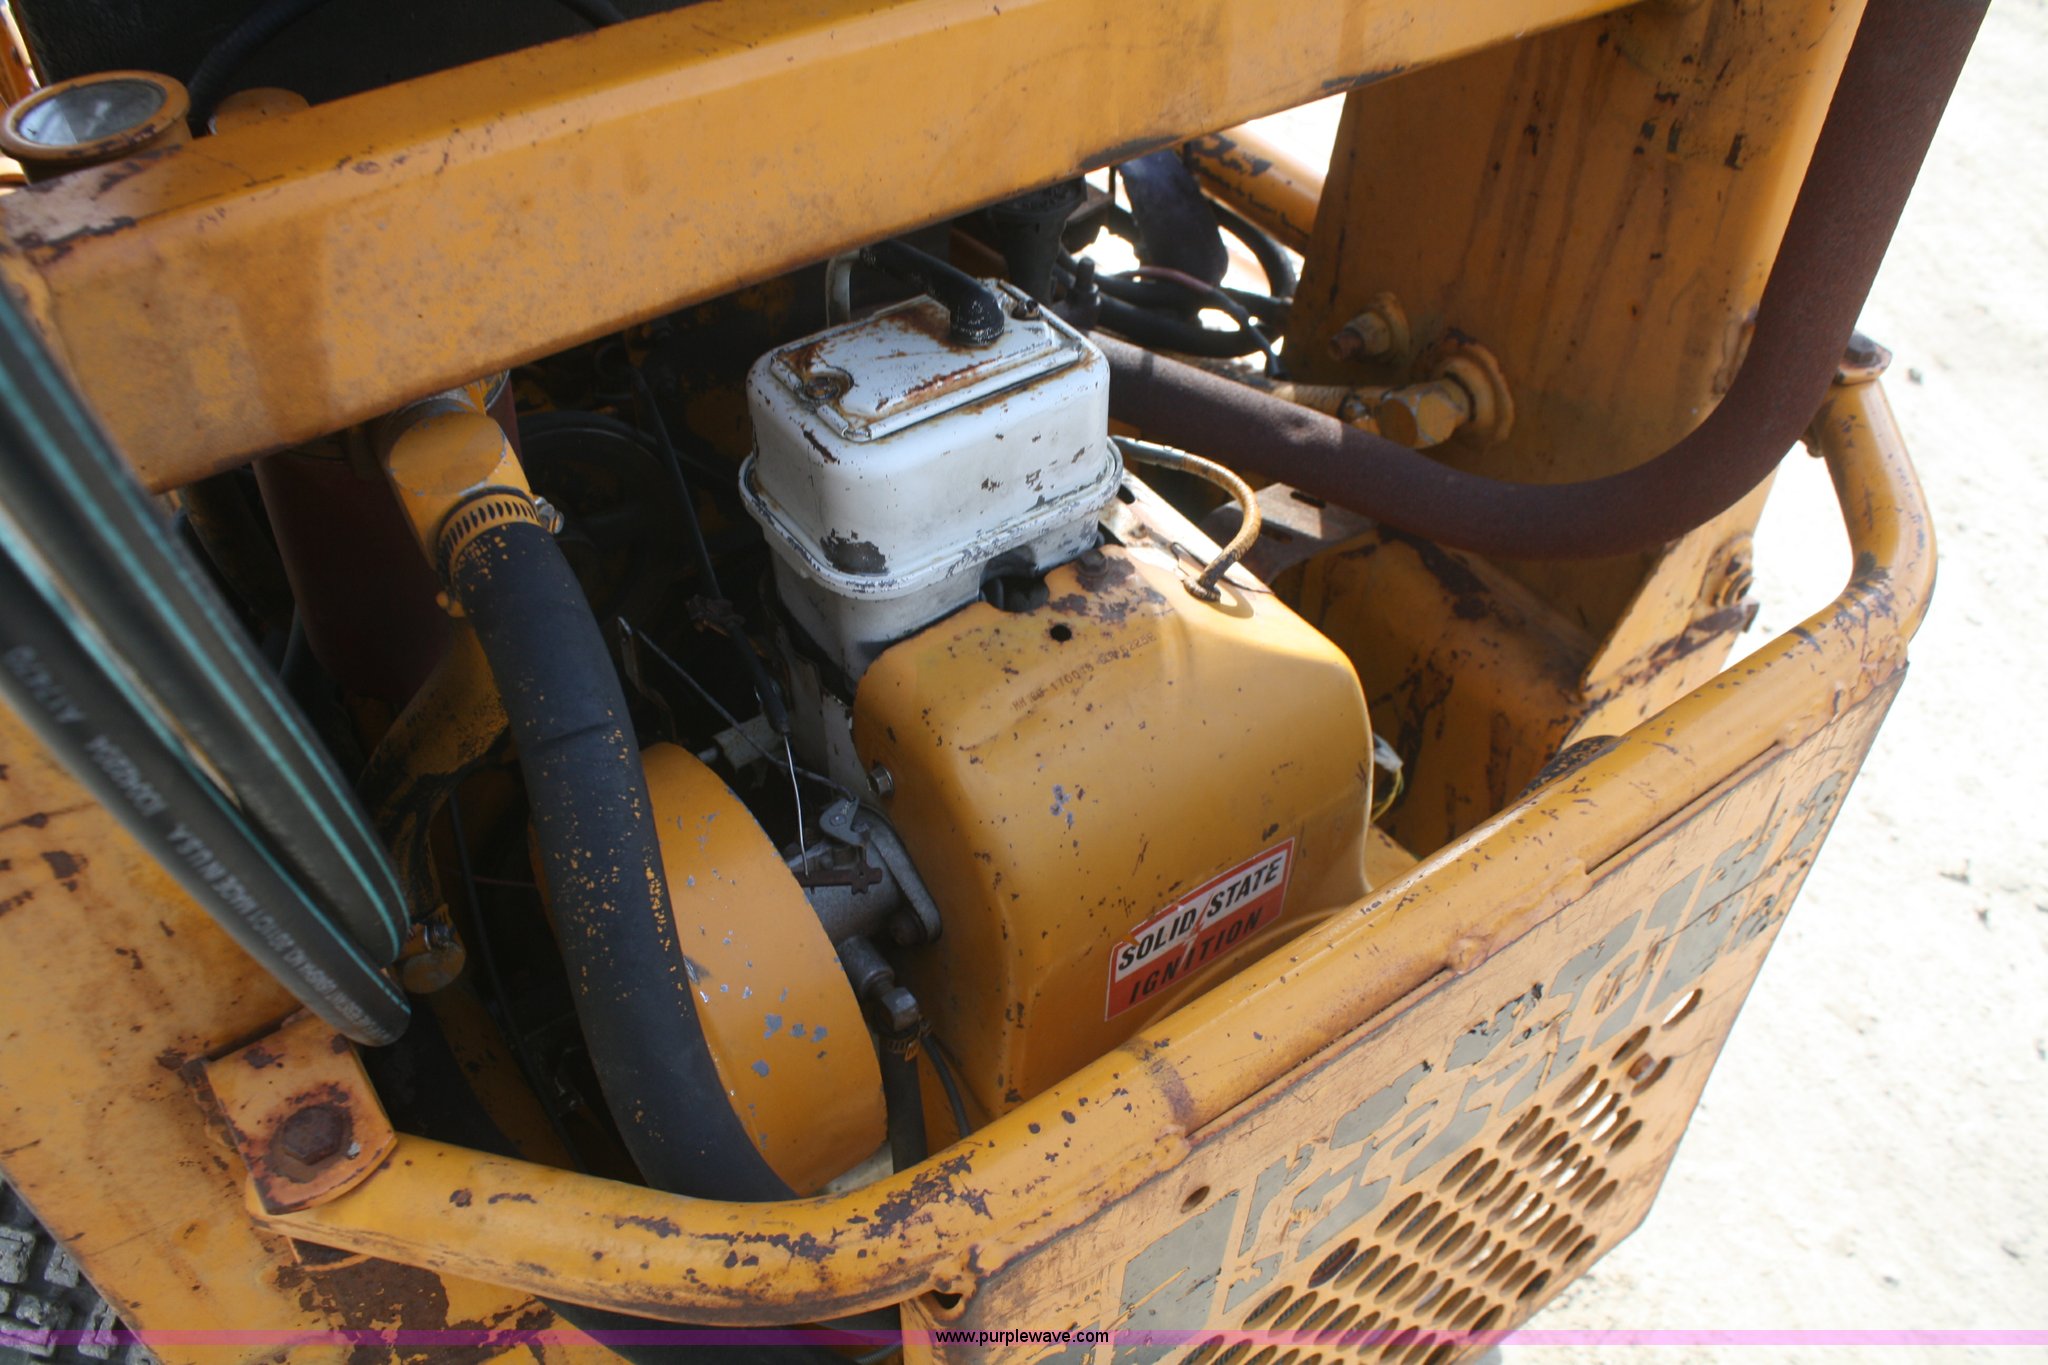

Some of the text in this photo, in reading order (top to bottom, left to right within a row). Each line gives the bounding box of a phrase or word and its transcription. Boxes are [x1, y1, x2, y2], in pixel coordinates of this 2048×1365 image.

[1118, 857, 1283, 971] SOLID STATE
[1129, 907, 1263, 1005] IGNITION
